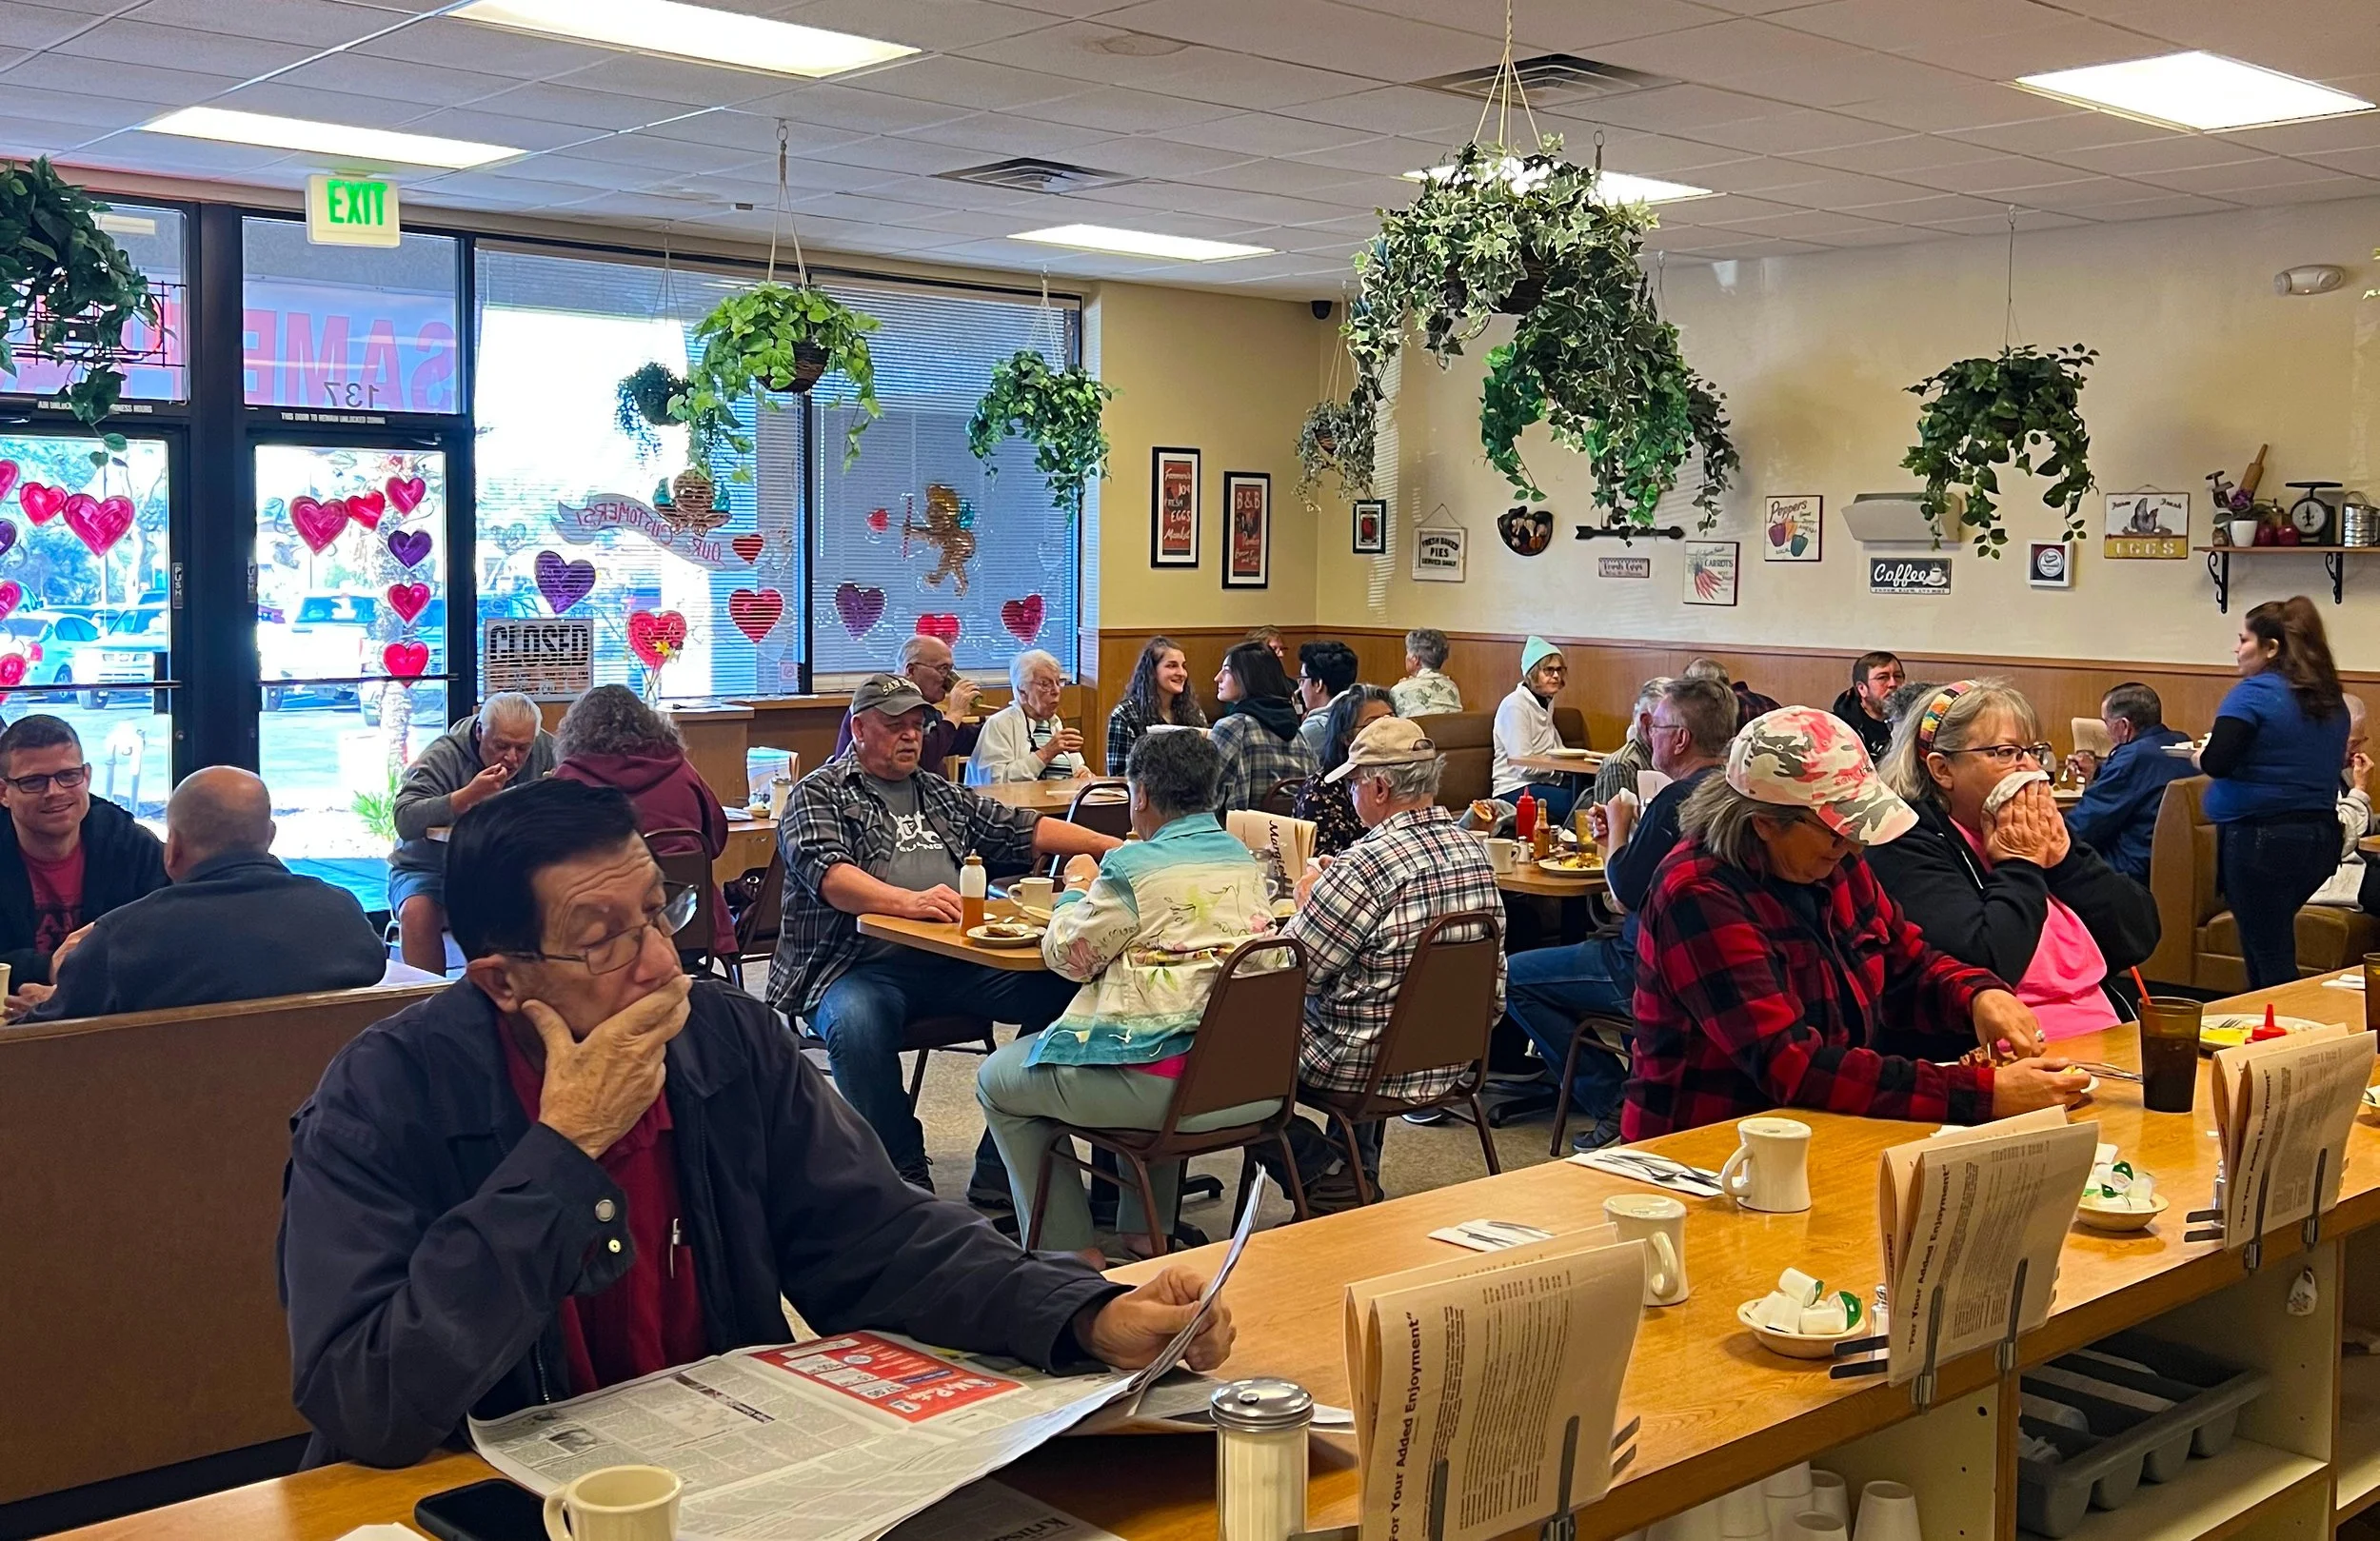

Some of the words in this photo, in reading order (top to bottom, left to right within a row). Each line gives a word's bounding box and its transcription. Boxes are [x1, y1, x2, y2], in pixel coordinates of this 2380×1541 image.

[327, 179, 387, 226] EXIT
[1237, 491, 1243, 509] B
[1244, 491, 1253, 508] &
[1254, 491, 1260, 509] B
[1170, 510, 1191, 524] EGGS
[1769, 500, 1808, 523] Peppers
[1421, 537, 1439, 547] FRESH
[1440, 537, 1459, 551] BAKED
[1430, 547, 1449, 558] PIES
[2115, 543, 2175, 554] EGGS
[1704, 559, 1734, 567] CARROTS
[1874, 563, 1927, 587] Coffee
[490, 624, 588, 666] CLOSED
[882, 679, 902, 696] SAN
[1912, 1287, 1922, 1321] Your
[1918, 1244, 1934, 1284] Added
[1396, 1415, 1413, 1468] Added
[1391, 1473, 1404, 1515] Your
